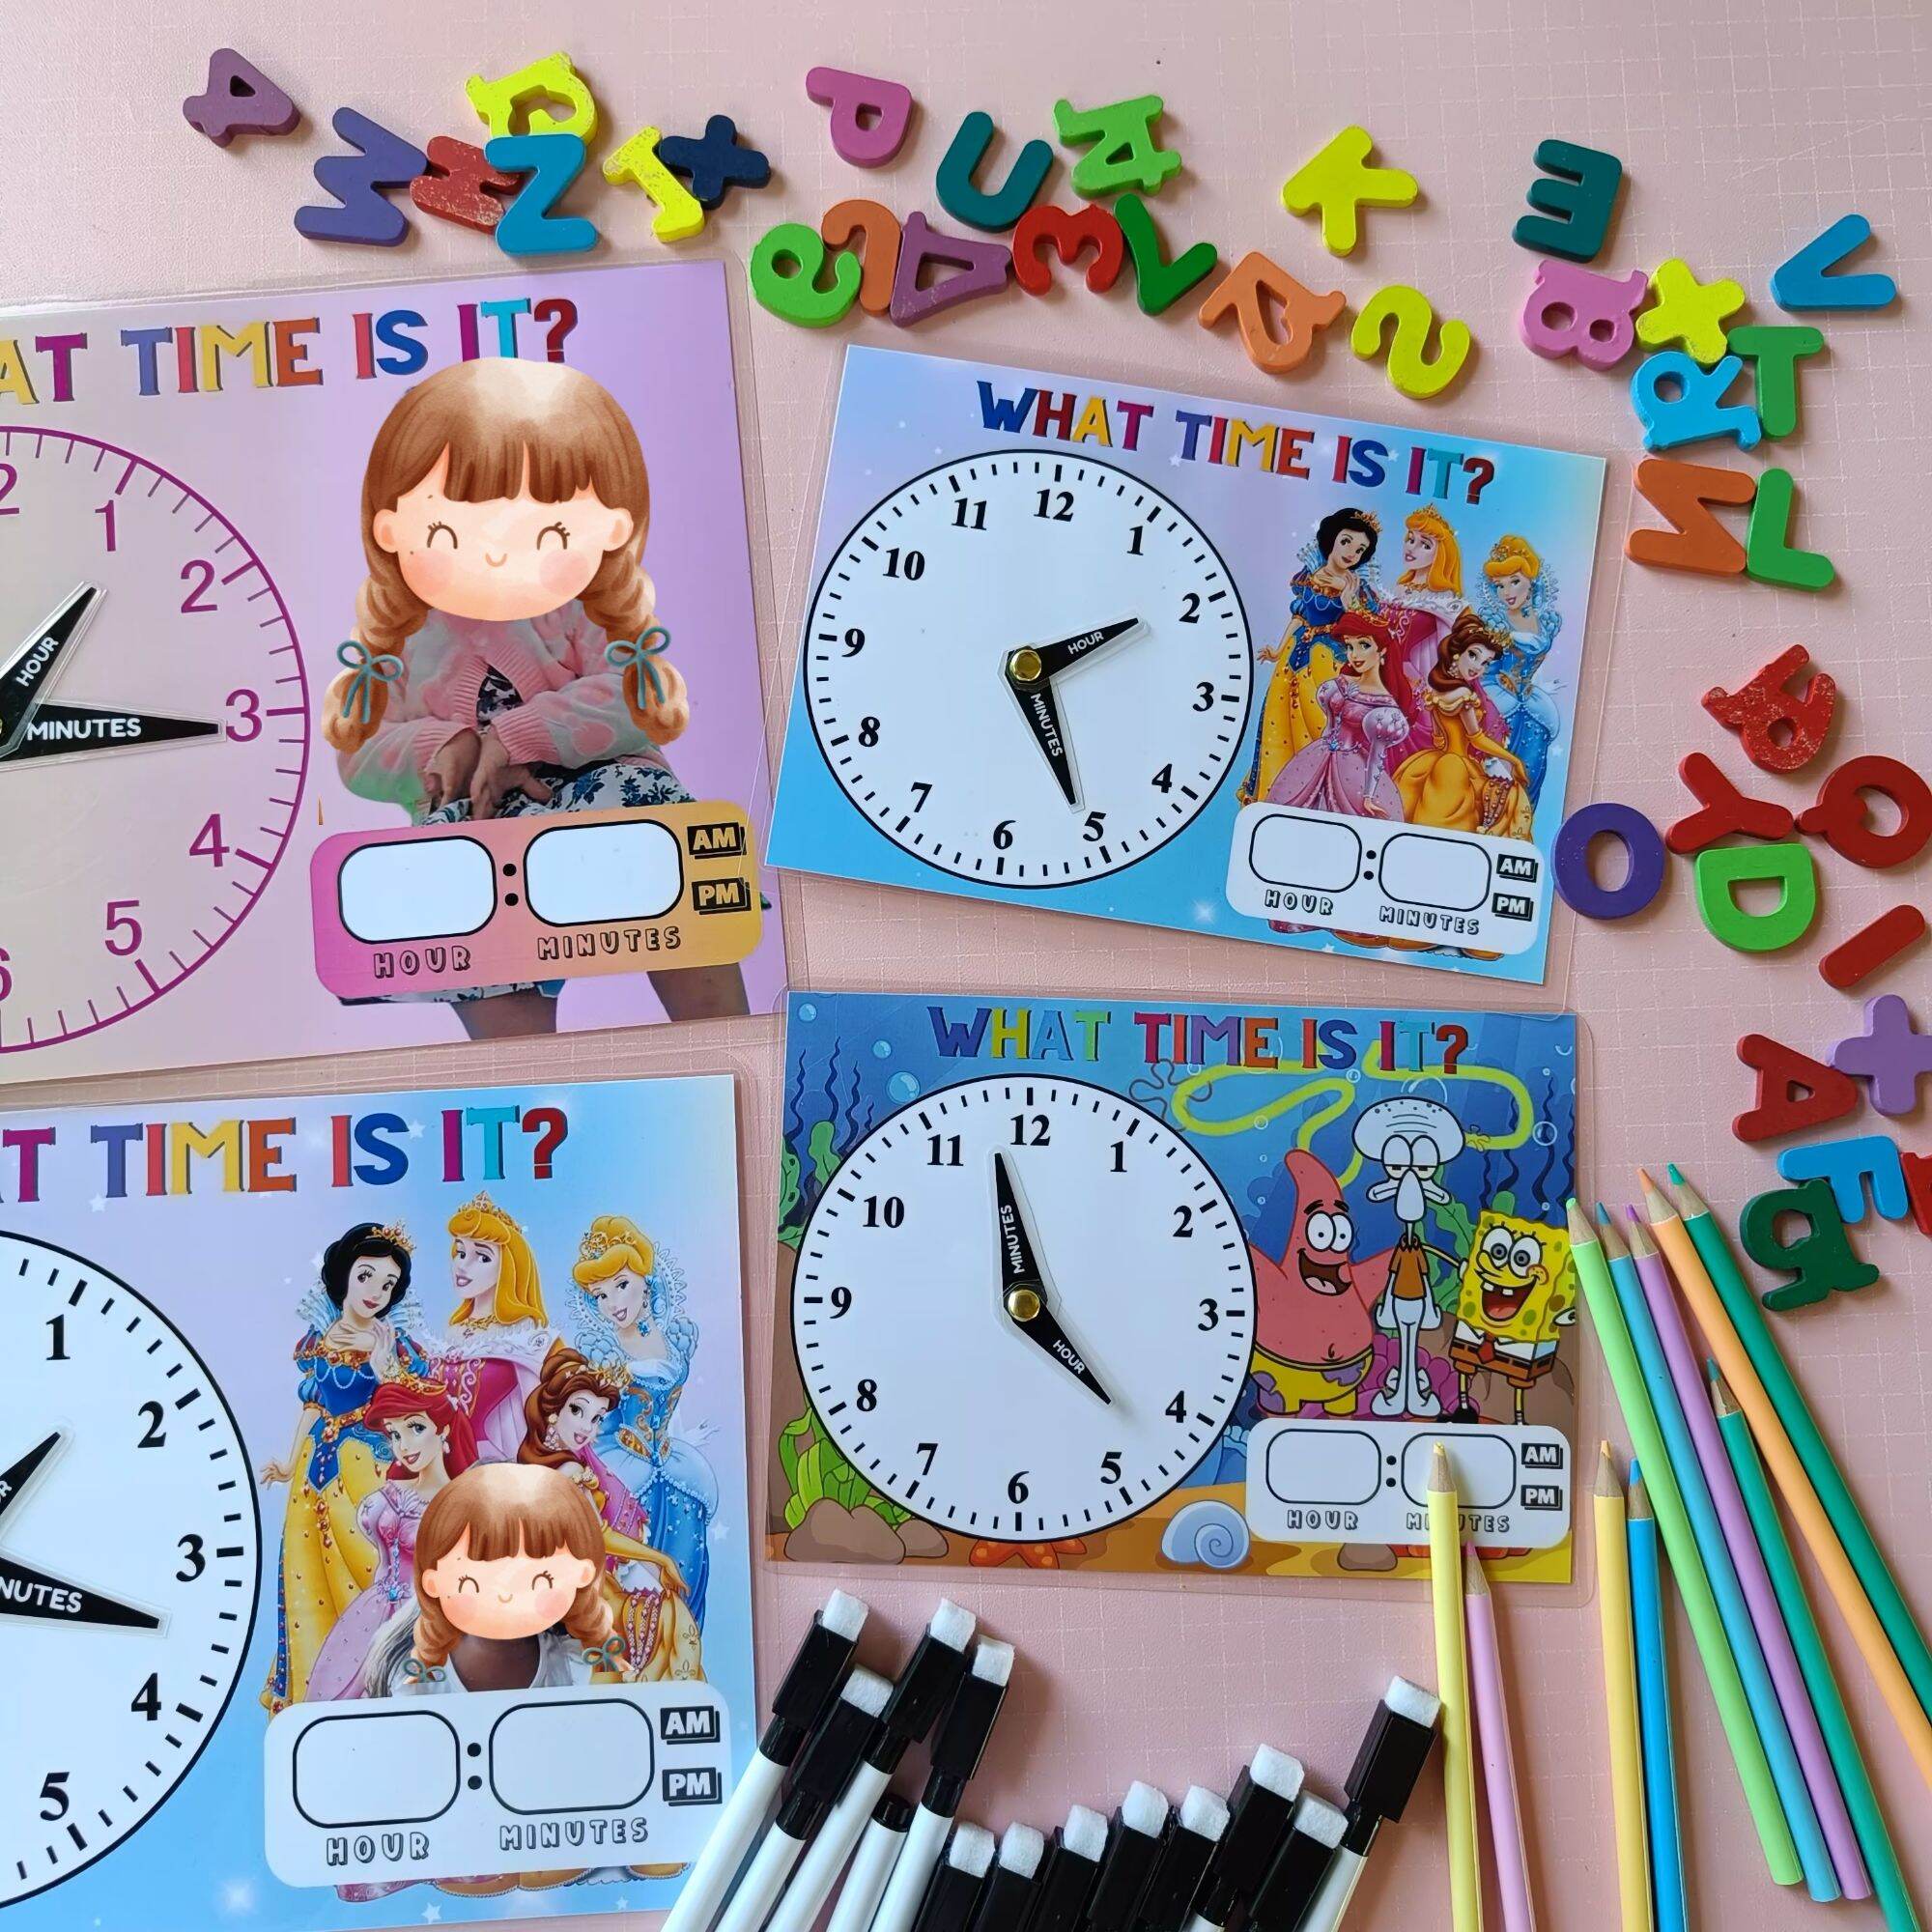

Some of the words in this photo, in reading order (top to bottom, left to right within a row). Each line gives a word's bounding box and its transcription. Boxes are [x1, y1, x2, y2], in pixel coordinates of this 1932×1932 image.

[120, 318, 324, 396] TIME
[353, 309, 429, 380] IS
[457, 298, 579, 363] IT?
[1727, 327, 1826, 440] T
[977, 381, 1154, 452] WHAT
[1176, 410, 1315, 480] TIME
[1331, 436, 1389, 488] IS
[1406, 446, 1495, 505] IT?
[952, 497, 988, 530] 11
[1035, 488, 1075, 522] 12
[95, 499, 116, 552] 1
[1127, 525, 1145, 555] 1
[883, 547, 925, 581] 10
[181, 559, 217, 613] 2
[1179, 592, 1201, 623] 2
[841, 628, 866, 658] 9
[1067, 631, 1104, 654] HOUR
[15, 636, 59, 687] HOUR
[1193, 681, 1214, 712] 3
[26, 718, 142, 741] MINUTES
[226, 689, 263, 742] 3
[858, 717, 880, 748] 8
[1031, 693, 1063, 757] MINUTES
[1151, 763, 1173, 793] 4
[911, 781, 933, 813] 7
[189, 813, 230, 867] 4
[693, 827, 737, 852] AM
[993, 819, 1016, 850] 6
[1083, 811, 1106, 842] 5
[1498, 858, 1532, 876] AM
[697, 883, 741, 907] PM
[1264, 889, 1333, 916] HOUR
[1378, 906, 1480, 935] MINUTES
[1496, 896, 1525, 915] PM
[105, 899, 142, 955] 5
[373, 946, 471, 980] HOUR
[537, 925, 682, 961] MINUTES
[926, 1006, 1111, 1062] WHAT
[1133, 1010, 1278, 1069] TIME
[1301, 1017, 1358, 1070] IS
[1379, 1020, 1468, 1074] IT?
[1732, 1034, 1859, 1143] A
[1009, 1115, 1051, 1147] 12
[0, 1126, 56, 1203] T
[91, 1117, 297, 1198] TIME
[330, 1112, 410, 1187] IS
[441, 1104, 568, 1182] IT?
[926, 1133, 965, 1168] 11
[1110, 1141, 1128, 1173] 1
[863, 1196, 905, 1230] 10
[1173, 1205, 1194, 1238] 2
[1001, 1205, 1025, 1274] MINUTES
[831, 1287, 852, 1320] 9
[1197, 1297, 1219, 1331] 3
[45, 1314, 71, 1360] 1
[1053, 1339, 1086, 1375] HOUR
[856, 1378, 878, 1412] 8
[1165, 1391, 1187, 1424] 4
[137, 1401, 166, 1448] 2
[917, 1443, 939, 1476] 7
[1100, 1451, 1122, 1485] 5
[1523, 1446, 1557, 1464] AM
[1008, 1470, 1029, 1504] 6
[1525, 1489, 1555, 1505] PM
[1287, 1510, 1358, 1530] HOUR
[176, 1534, 206, 1581] 3
[131, 1672, 161, 1720] 4
[666, 1710, 711, 1735] AM
[40, 1772, 70, 1821] 5
[668, 1773, 712, 1797] PM
[326, 1832, 430, 1866] HOUR
[499, 1817, 649, 1851] MINUTES
